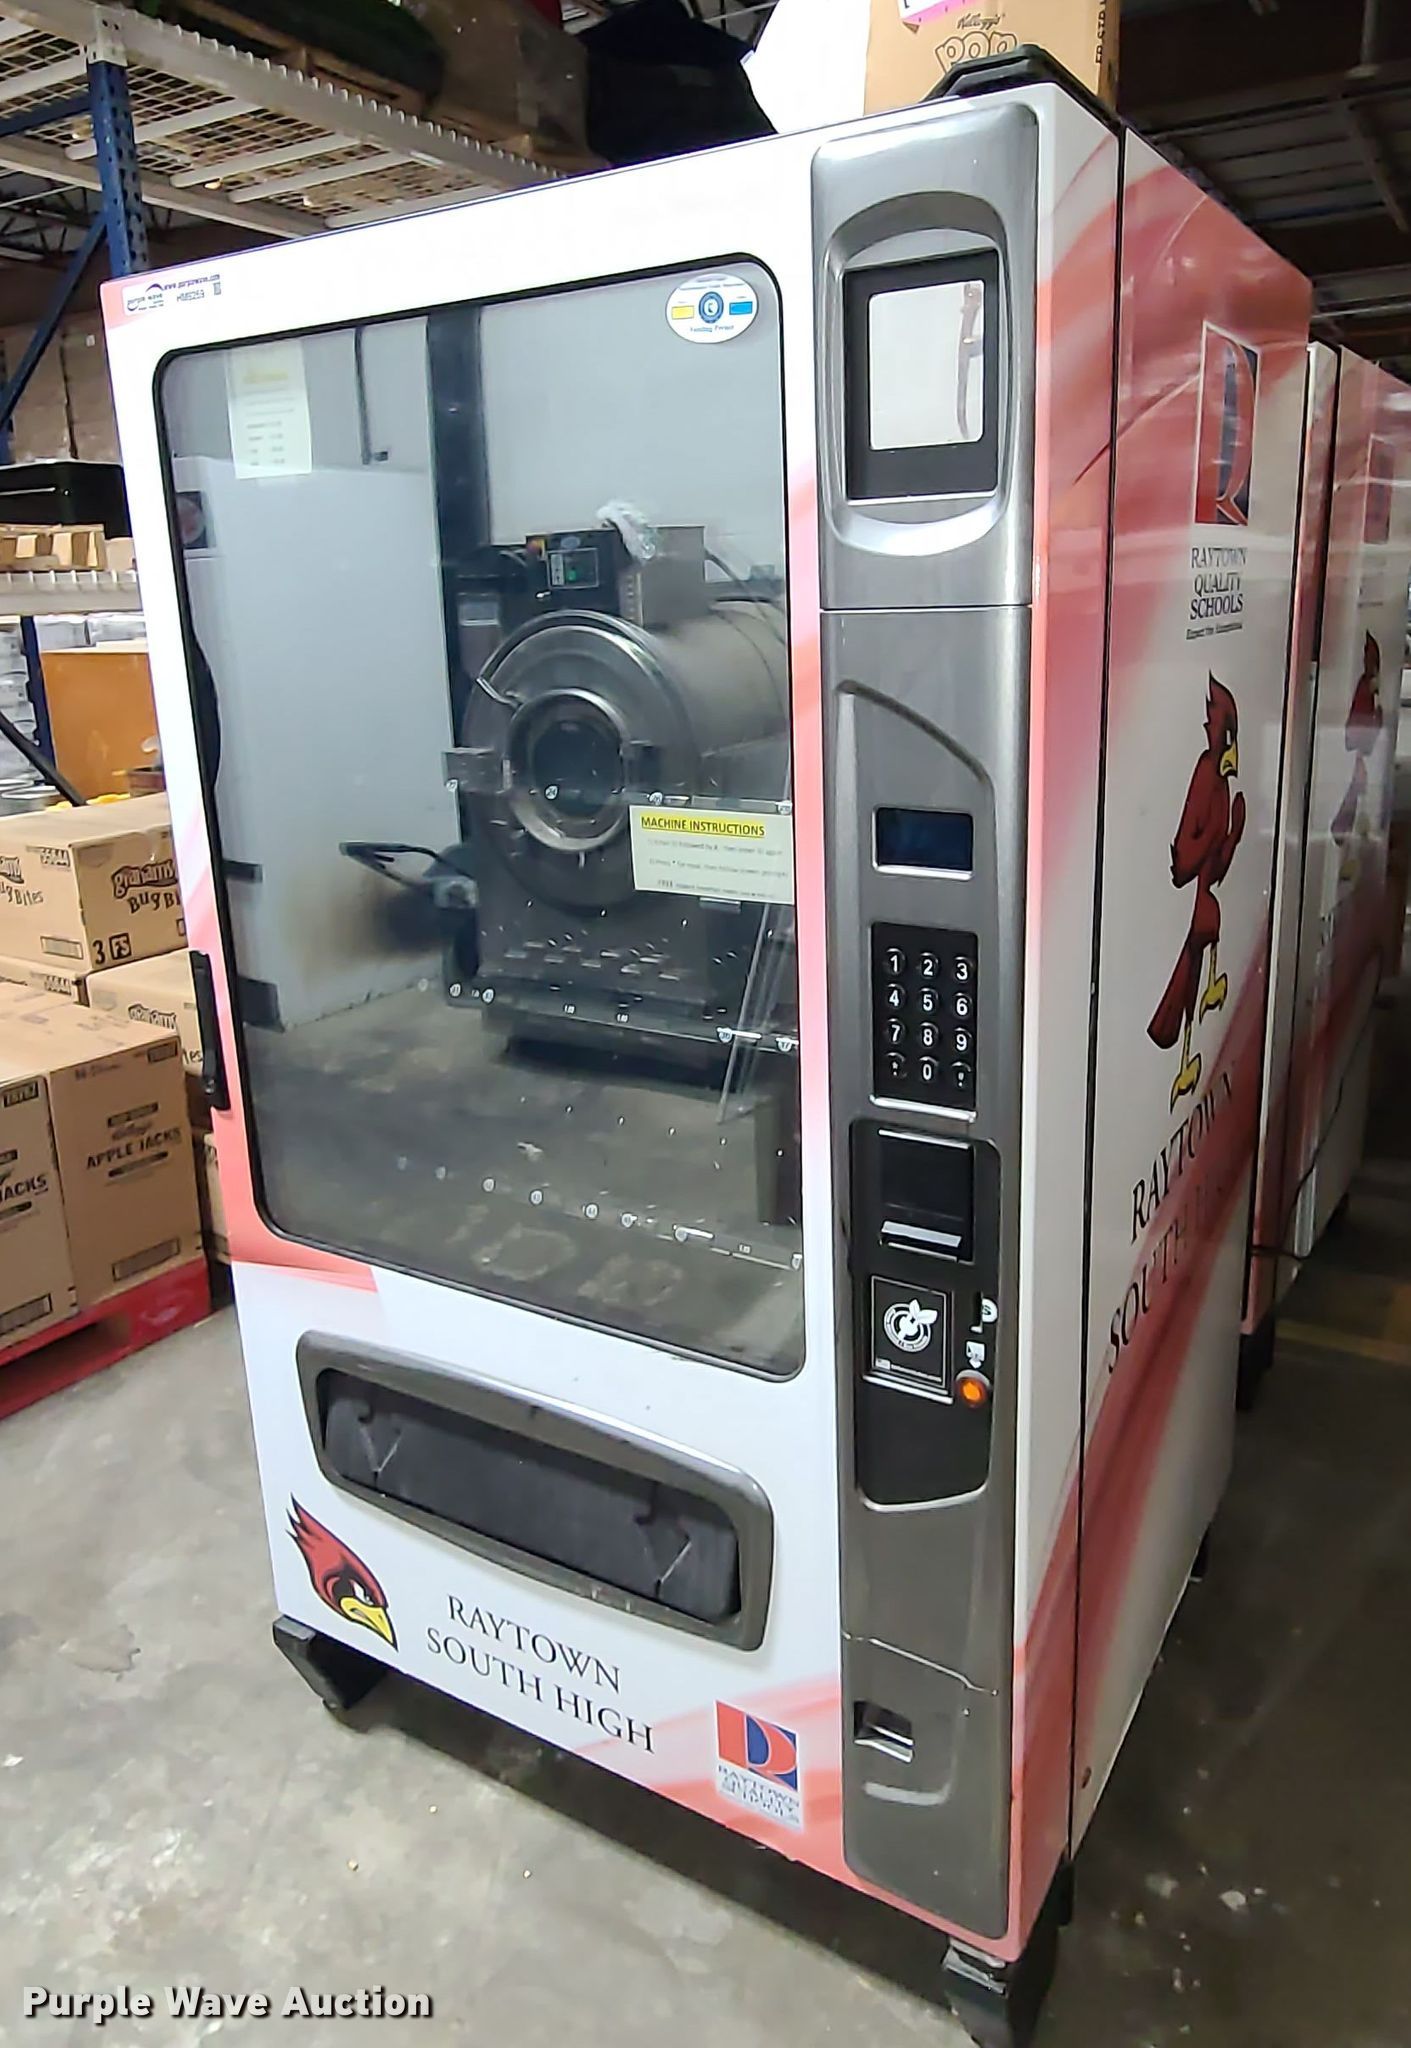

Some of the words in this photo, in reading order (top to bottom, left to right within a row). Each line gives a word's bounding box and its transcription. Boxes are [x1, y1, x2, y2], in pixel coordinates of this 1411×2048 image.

[1191, 547, 1247, 569] RAYTOWN
[1195, 572, 1241, 597] QUALITY
[1190, 594, 1243, 620] SCHOOLS
[641, 817, 687, 830] MACHINE
[690, 819, 765, 837] INSTRUCTIONS
[14, 889, 44, 906] Bites
[128, 891, 160, 914] Bug
[92, 939, 105, 964] 3
[890, 954, 898, 973] 1
[923, 959, 933, 976] 2
[956, 962, 968, 980] 3
[889, 989, 899, 1007] 4
[922, 994, 933, 1012] 5
[956, 998, 968, 1016] 6
[891, 1024, 900, 1042] 7
[923, 1028, 933, 1046] 8
[956, 1034, 967, 1051] 9
[922, 1063, 932, 1081] 0
[87, 1143, 132, 1170] APPLE
[447, 1594, 620, 1694] RAYTOWN
[427, 1627, 543, 1703] SOUTH
[554, 1684, 655, 1755] HIGH
